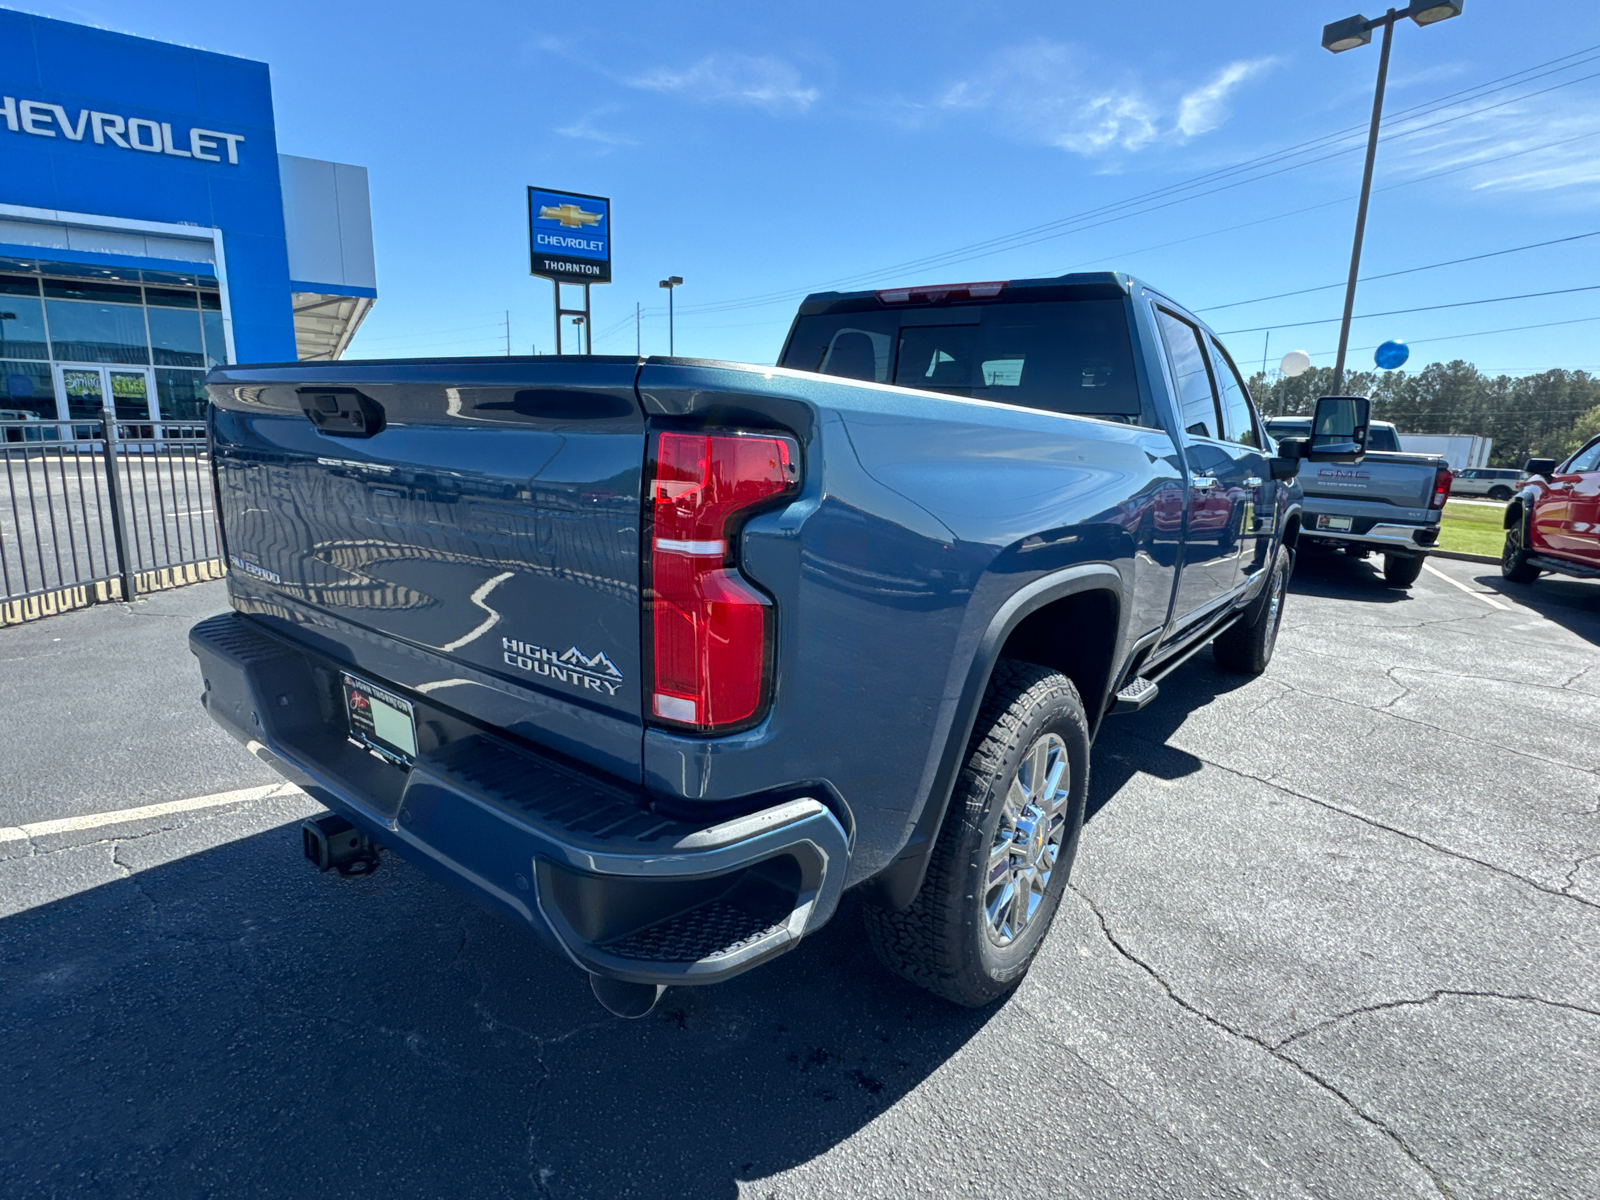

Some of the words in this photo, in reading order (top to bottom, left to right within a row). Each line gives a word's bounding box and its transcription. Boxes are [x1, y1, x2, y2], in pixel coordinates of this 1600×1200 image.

[537, 234, 604, 252] CHEVROLET
[544, 260, 600, 275] THORNTON
[1318, 468, 1371, 480] GMC
[1317, 481, 1368, 489] SIERRA
[502, 636, 560, 664] HIGH
[503, 652, 623, 696] COUNTRY
[355, 680, 372, 695] JOHN
[372, 688, 408, 712] THORNTON
